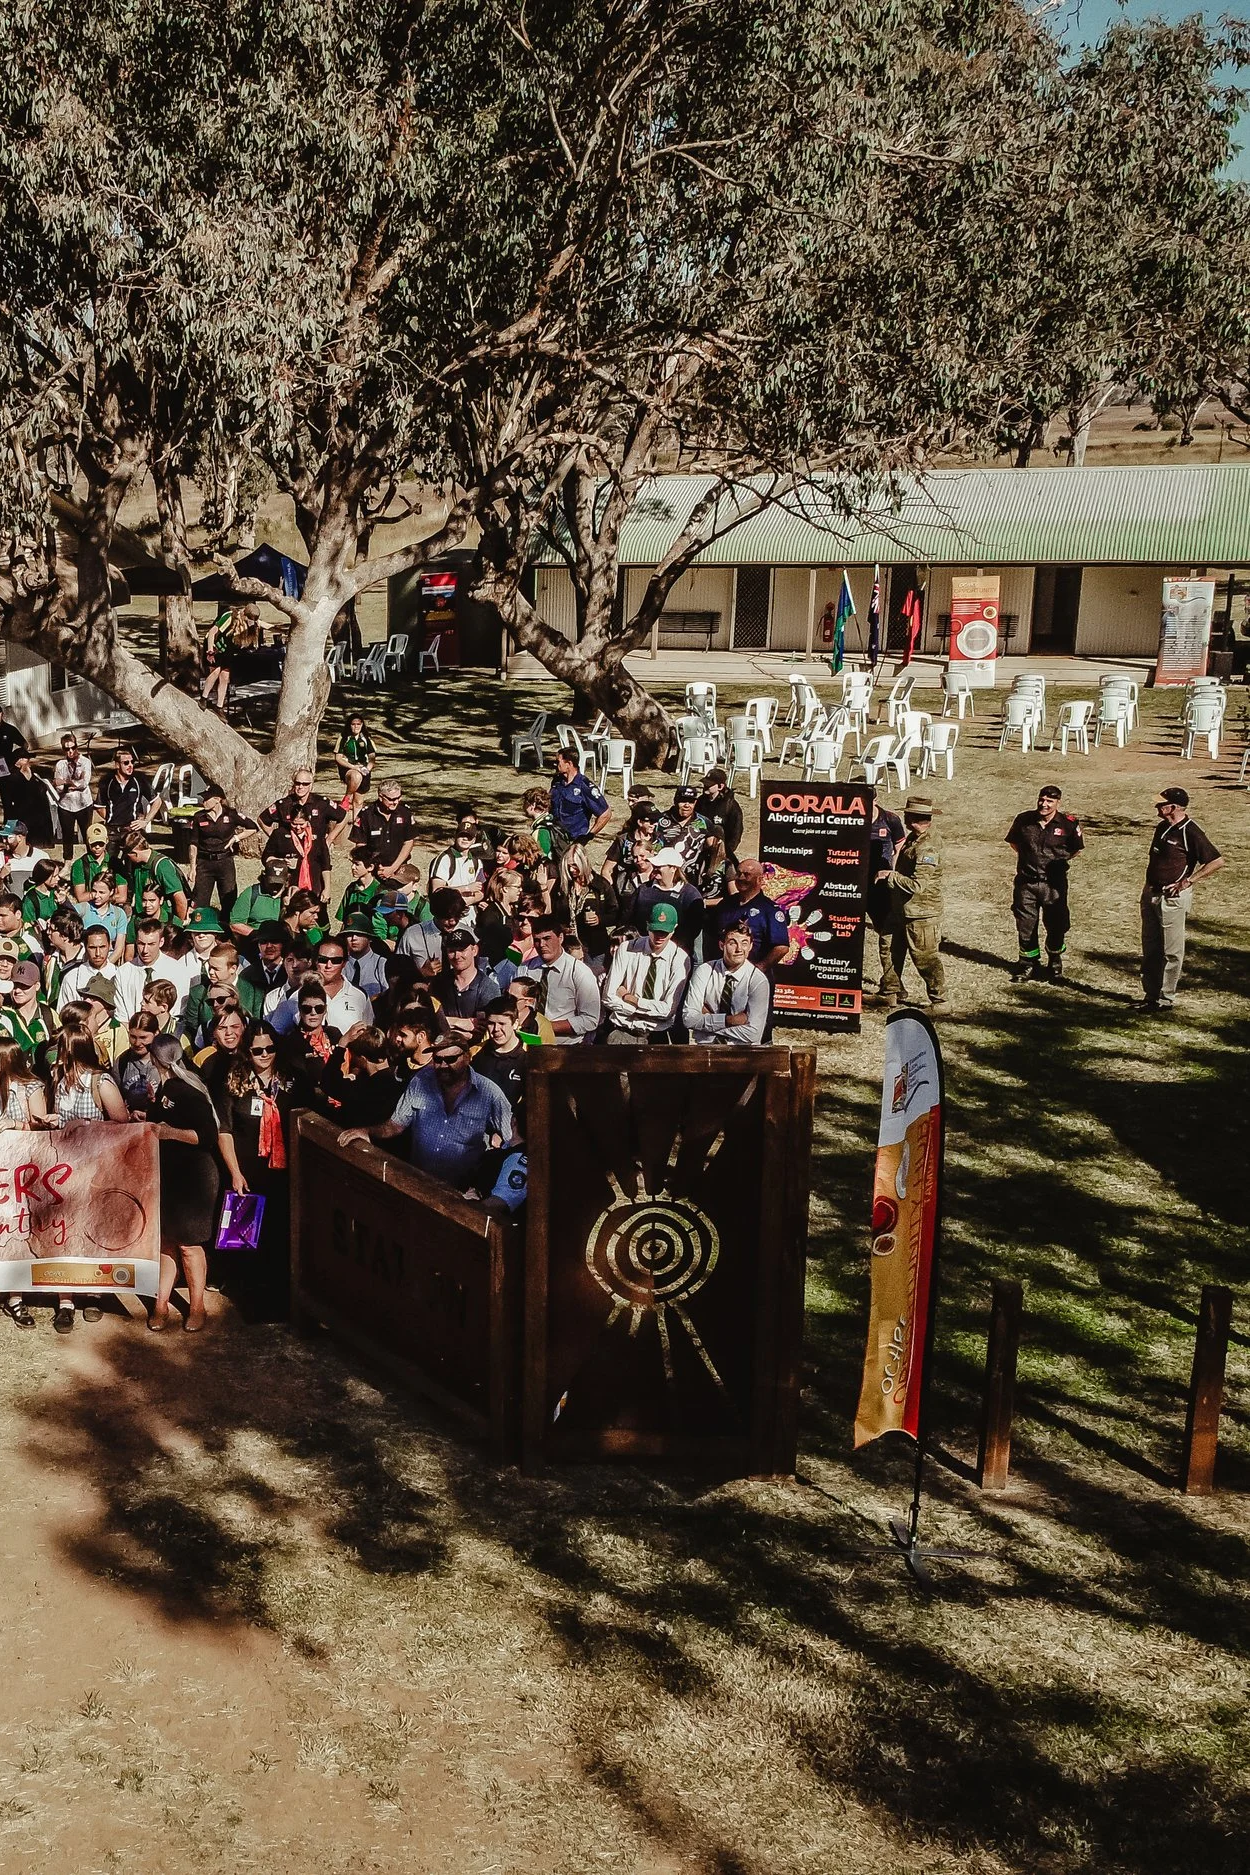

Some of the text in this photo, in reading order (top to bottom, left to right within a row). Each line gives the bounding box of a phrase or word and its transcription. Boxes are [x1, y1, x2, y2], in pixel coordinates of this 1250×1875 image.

[766, 793, 866, 816] OORALA
[767, 813, 865, 826] Aboriginal Centre
[763, 846, 813, 856] Scholarships
[827, 849, 859, 857] Tutorial
[826, 857, 859, 865] Support
[823, 882, 857, 892] Abstudy
[819, 889, 862, 898] Assistance
[832, 922, 856, 931] Study
[817, 957, 850, 967] Tertiary
[810, 964, 857, 973] Preparation
[817, 973, 849, 981] Courses
